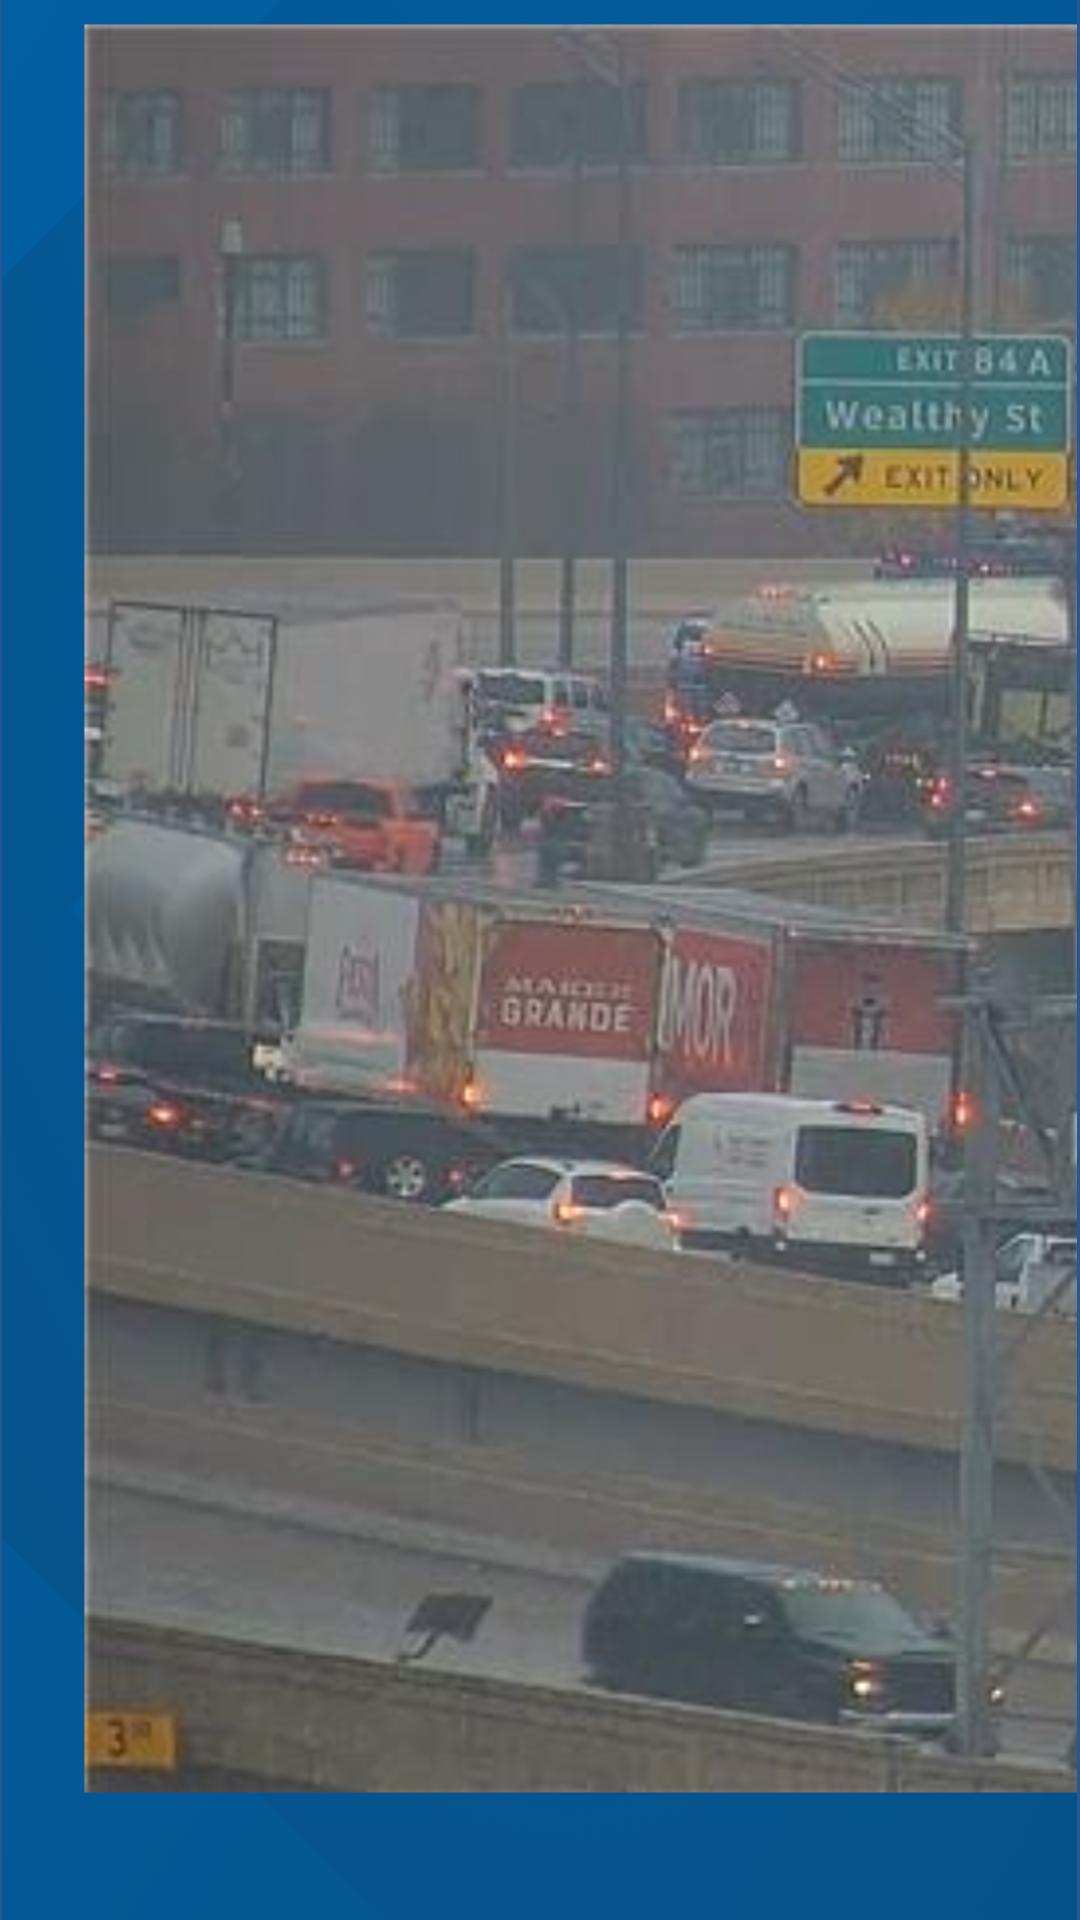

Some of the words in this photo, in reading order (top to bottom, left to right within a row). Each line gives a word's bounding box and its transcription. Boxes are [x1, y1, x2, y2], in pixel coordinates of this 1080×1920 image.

[897, 346, 957, 371] EXIT
[826, 400, 988, 441] Wealthy
[1005, 404, 1043, 434] St
[885, 464, 949, 489] EXIT
[962, 466, 1043, 491] ONLY
[501, 998, 633, 1031] GRANDE
